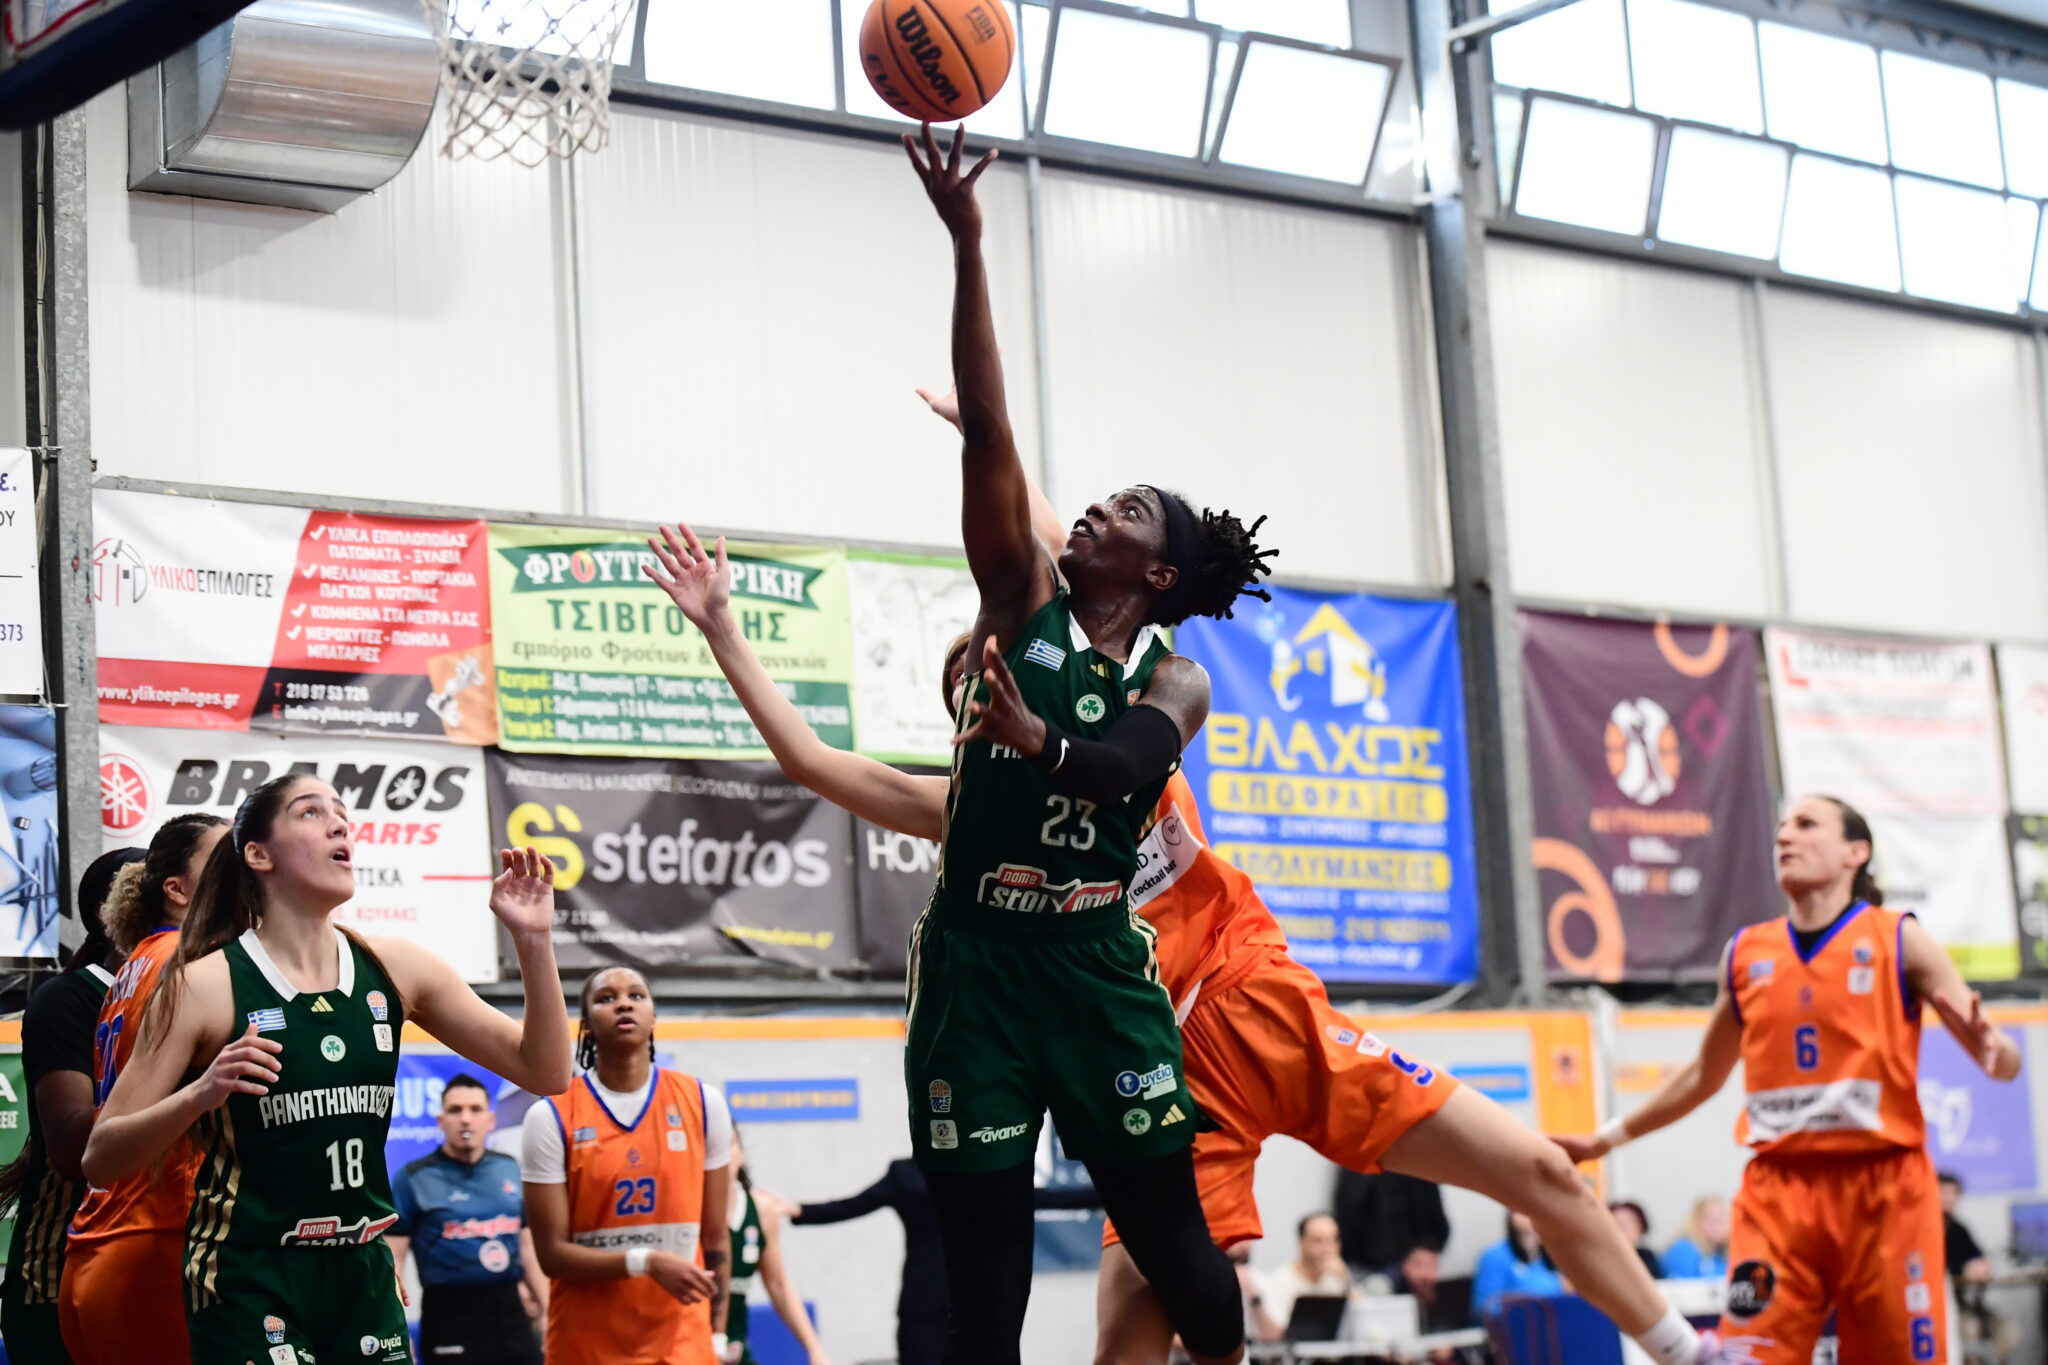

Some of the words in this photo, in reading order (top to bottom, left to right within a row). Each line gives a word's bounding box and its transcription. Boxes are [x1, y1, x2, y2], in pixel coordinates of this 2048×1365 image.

[895, 5, 961, 106] Wilson
[328, 526, 369, 544] ΥΛΙΚΑ
[148, 564, 274, 598] ΥΛΙΚΟΕΠΙΛΟΓΕΣ
[523, 548, 805, 602] ΦΡΟΥΤΕΡΙΚΗ
[451, 611, 480, 627] ΣΑΣ
[547, 599, 788, 642] ΤΣΙΒΓΟΗΣ
[1229, 780, 1427, 817] ΑΠΟΦΡΑΞΕΙΣ
[1040, 794, 1097, 851] 23
[591, 818, 832, 888] stefatos
[1002, 871, 1038, 885] pame
[1133, 867, 1167, 897] cocktail
[1795, 1025, 1819, 1070] 6
[980, 1122, 1028, 1143] avance
[326, 1138, 365, 1191] 18
[615, 1177, 656, 1216] 23
[301, 1222, 334, 1237] pame
[1910, 1316, 1935, 1361] 6
